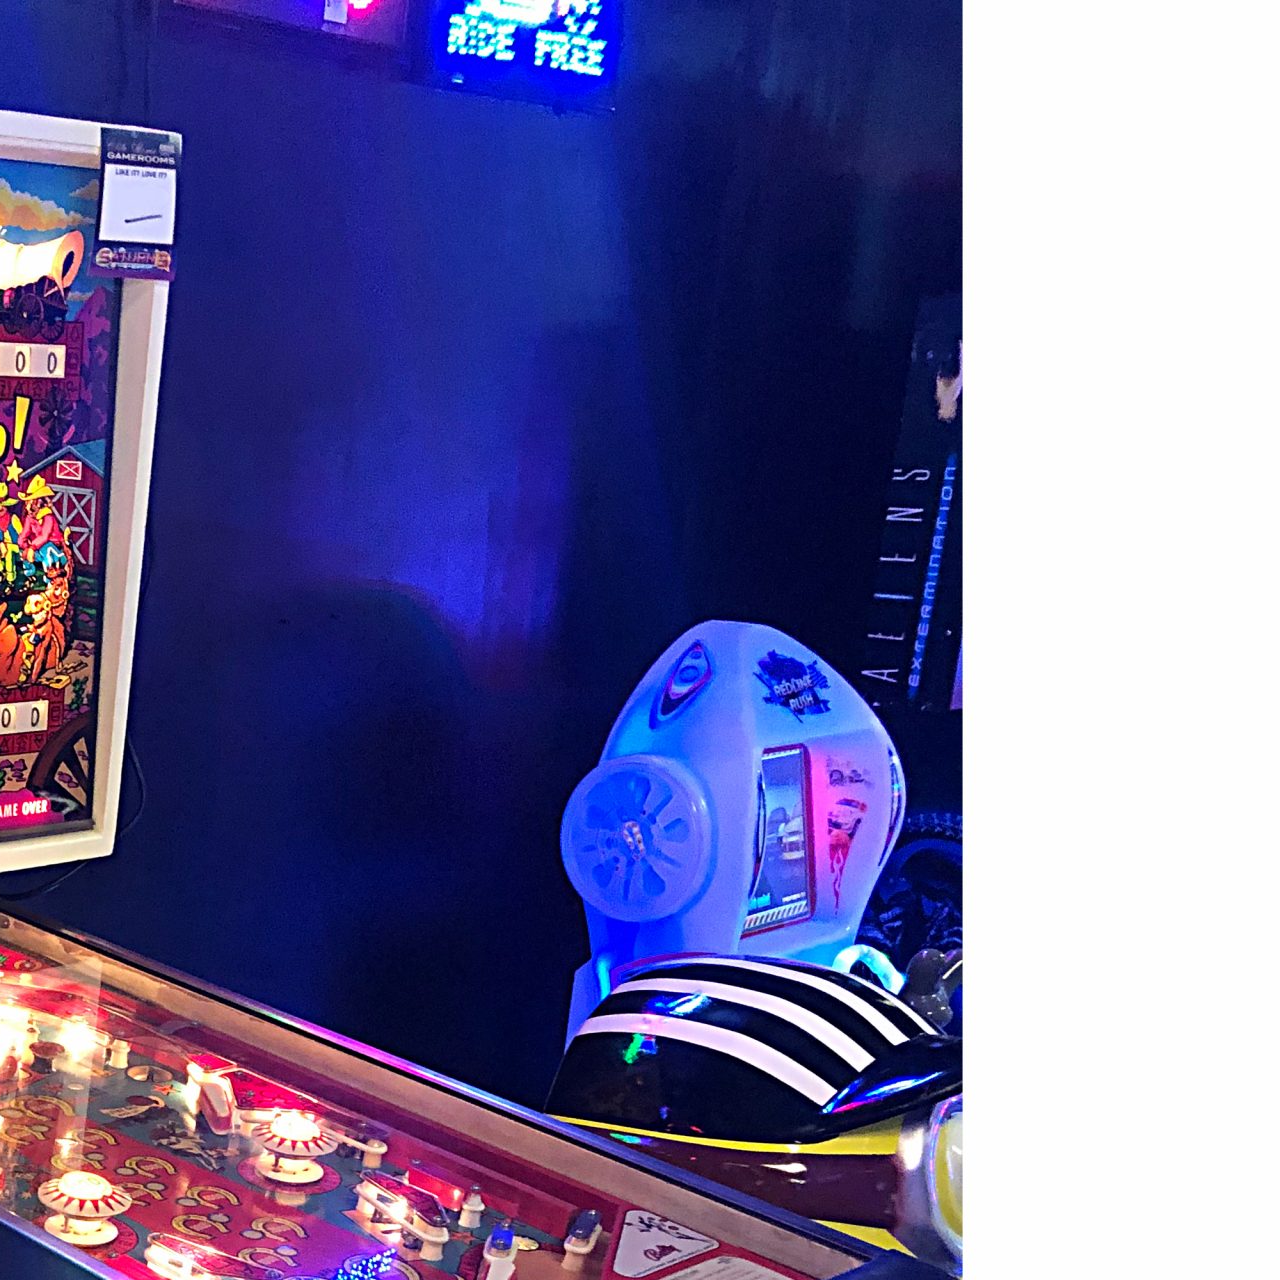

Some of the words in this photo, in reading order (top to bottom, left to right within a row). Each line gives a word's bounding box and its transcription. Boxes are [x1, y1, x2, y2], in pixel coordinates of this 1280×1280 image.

[447, 13, 516, 61] RIDE
[533, 29, 608, 76] FREE
[107, 151, 175, 165] GAMEROOMS
[861, 468, 931, 683] ALIENS
[908, 466, 956, 688] EXTERMINATION
[22, 799, 48, 815] OVER
